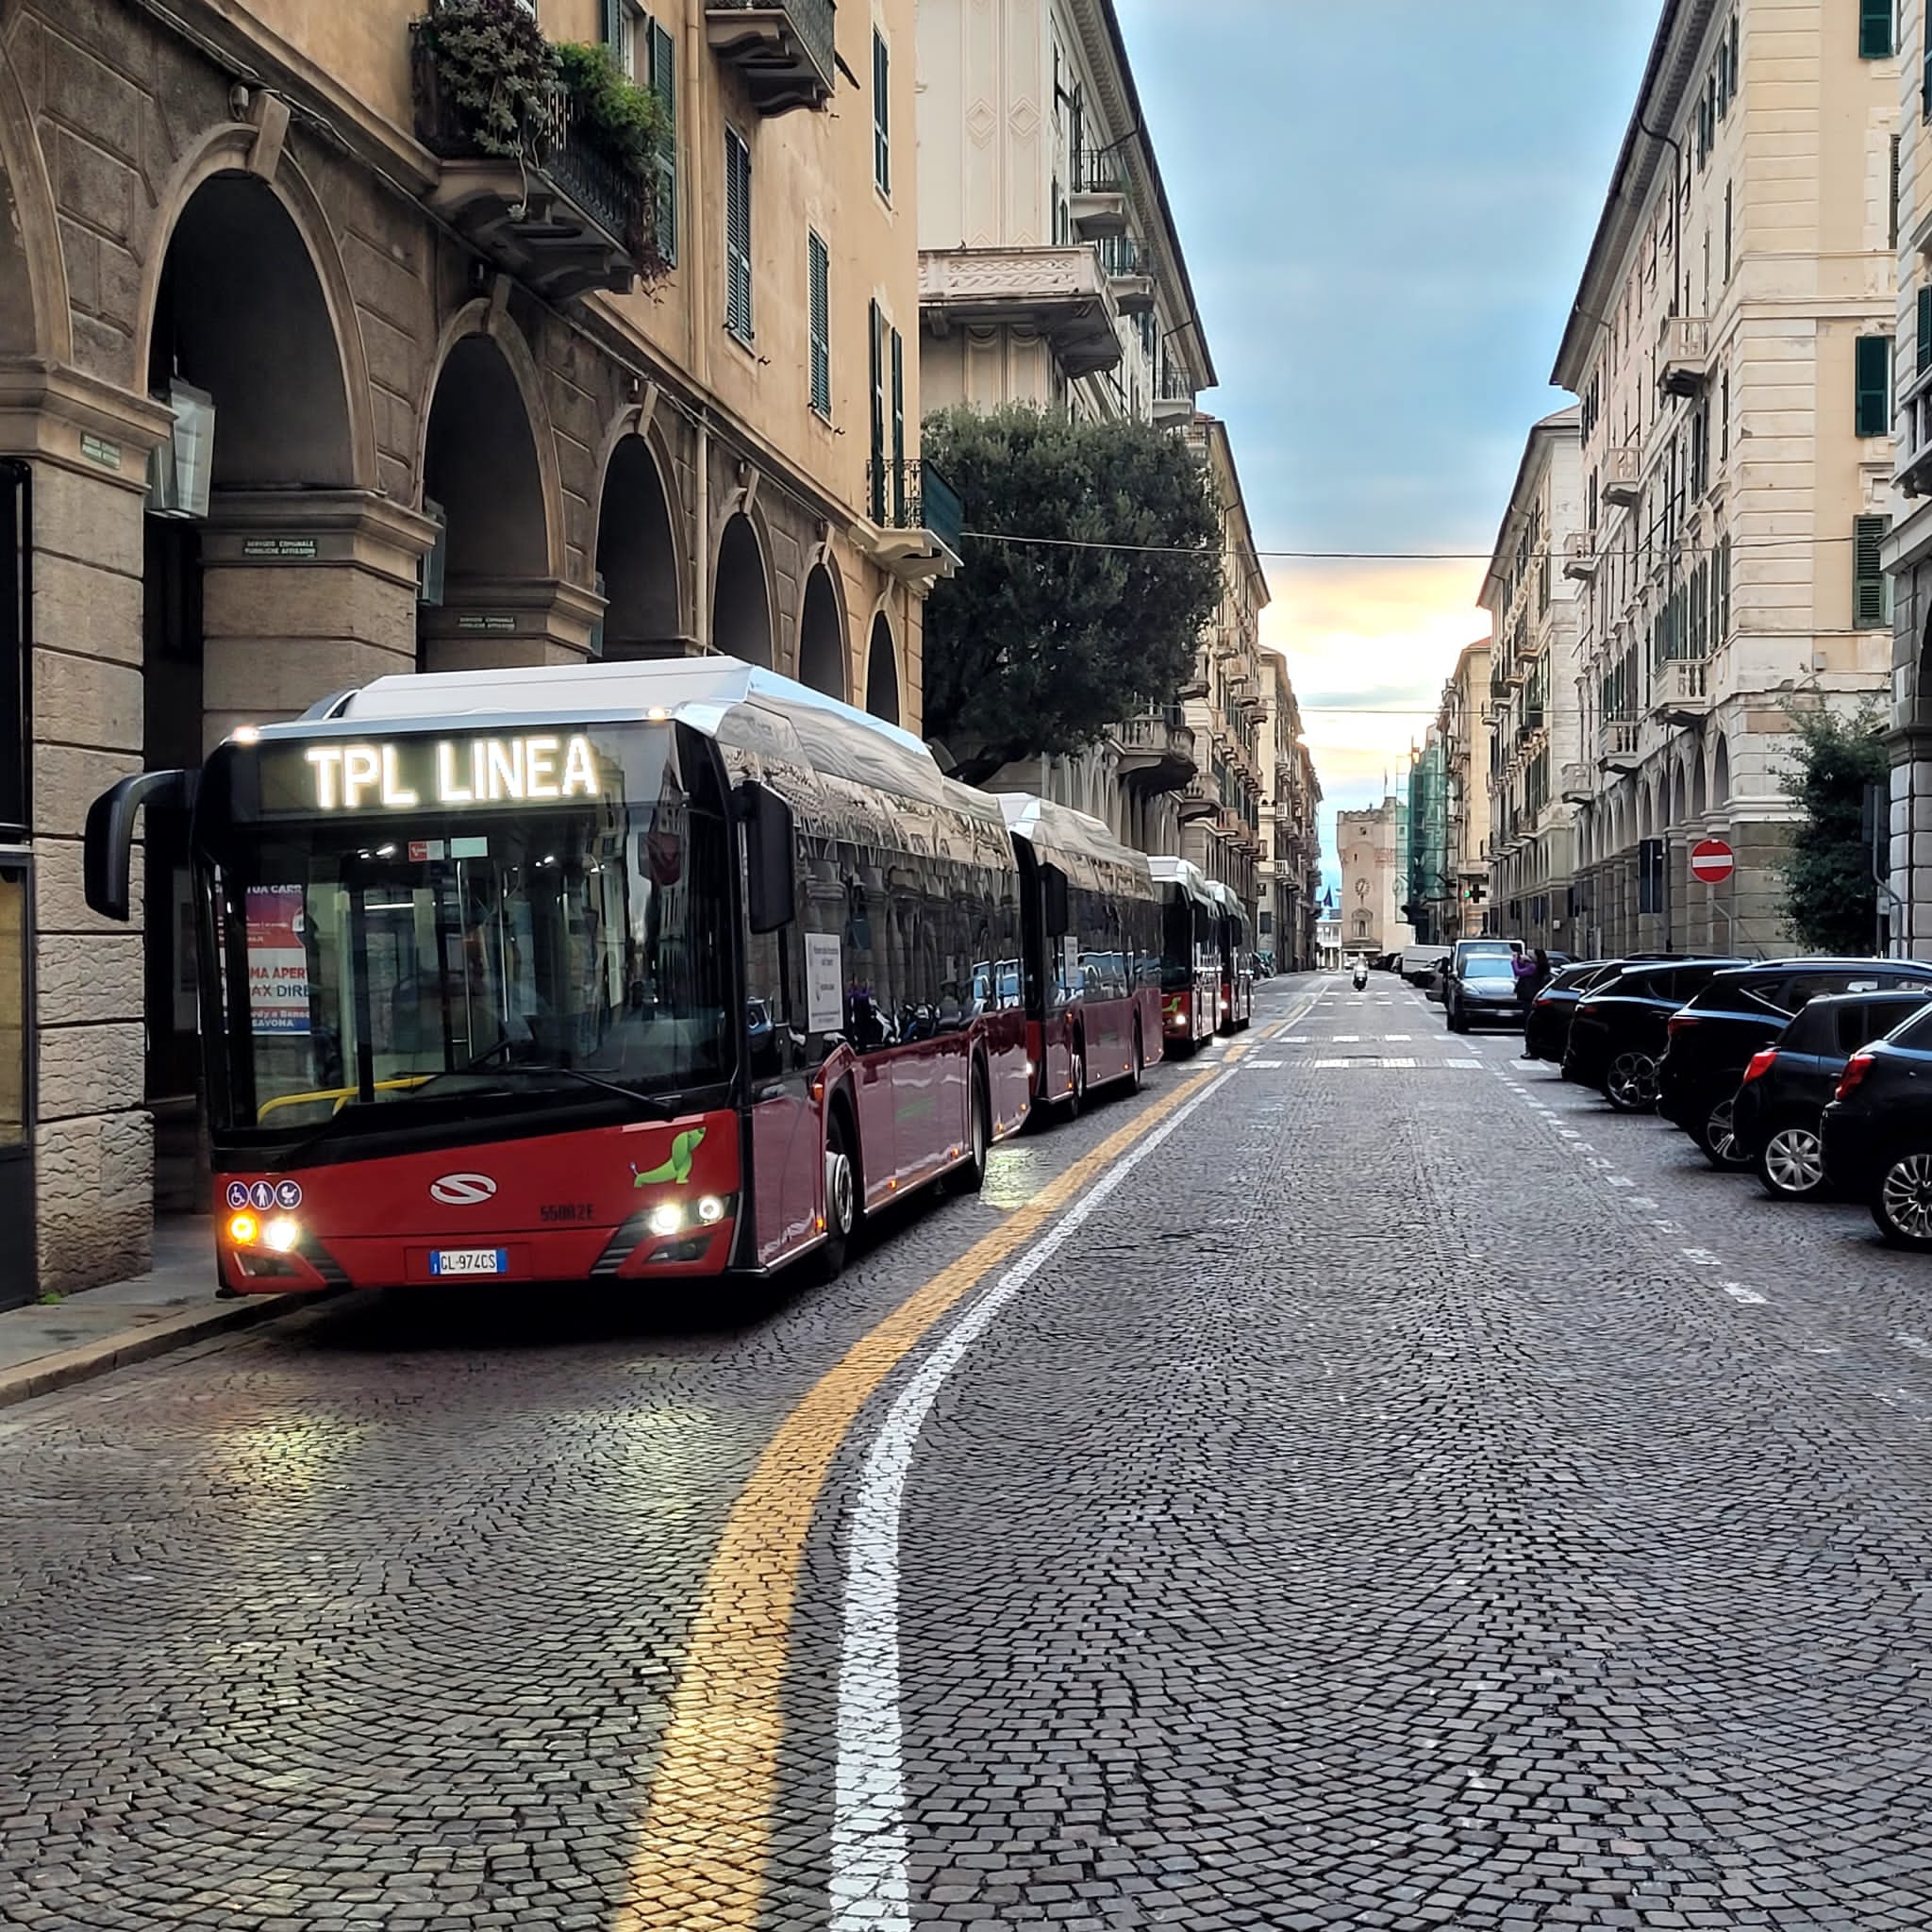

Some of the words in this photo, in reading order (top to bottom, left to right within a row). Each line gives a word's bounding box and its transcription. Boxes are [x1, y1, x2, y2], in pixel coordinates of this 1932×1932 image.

[305, 743, 419, 809] TPL
[437, 734, 600, 802] LINEA
[273, 966, 308, 979] APER
